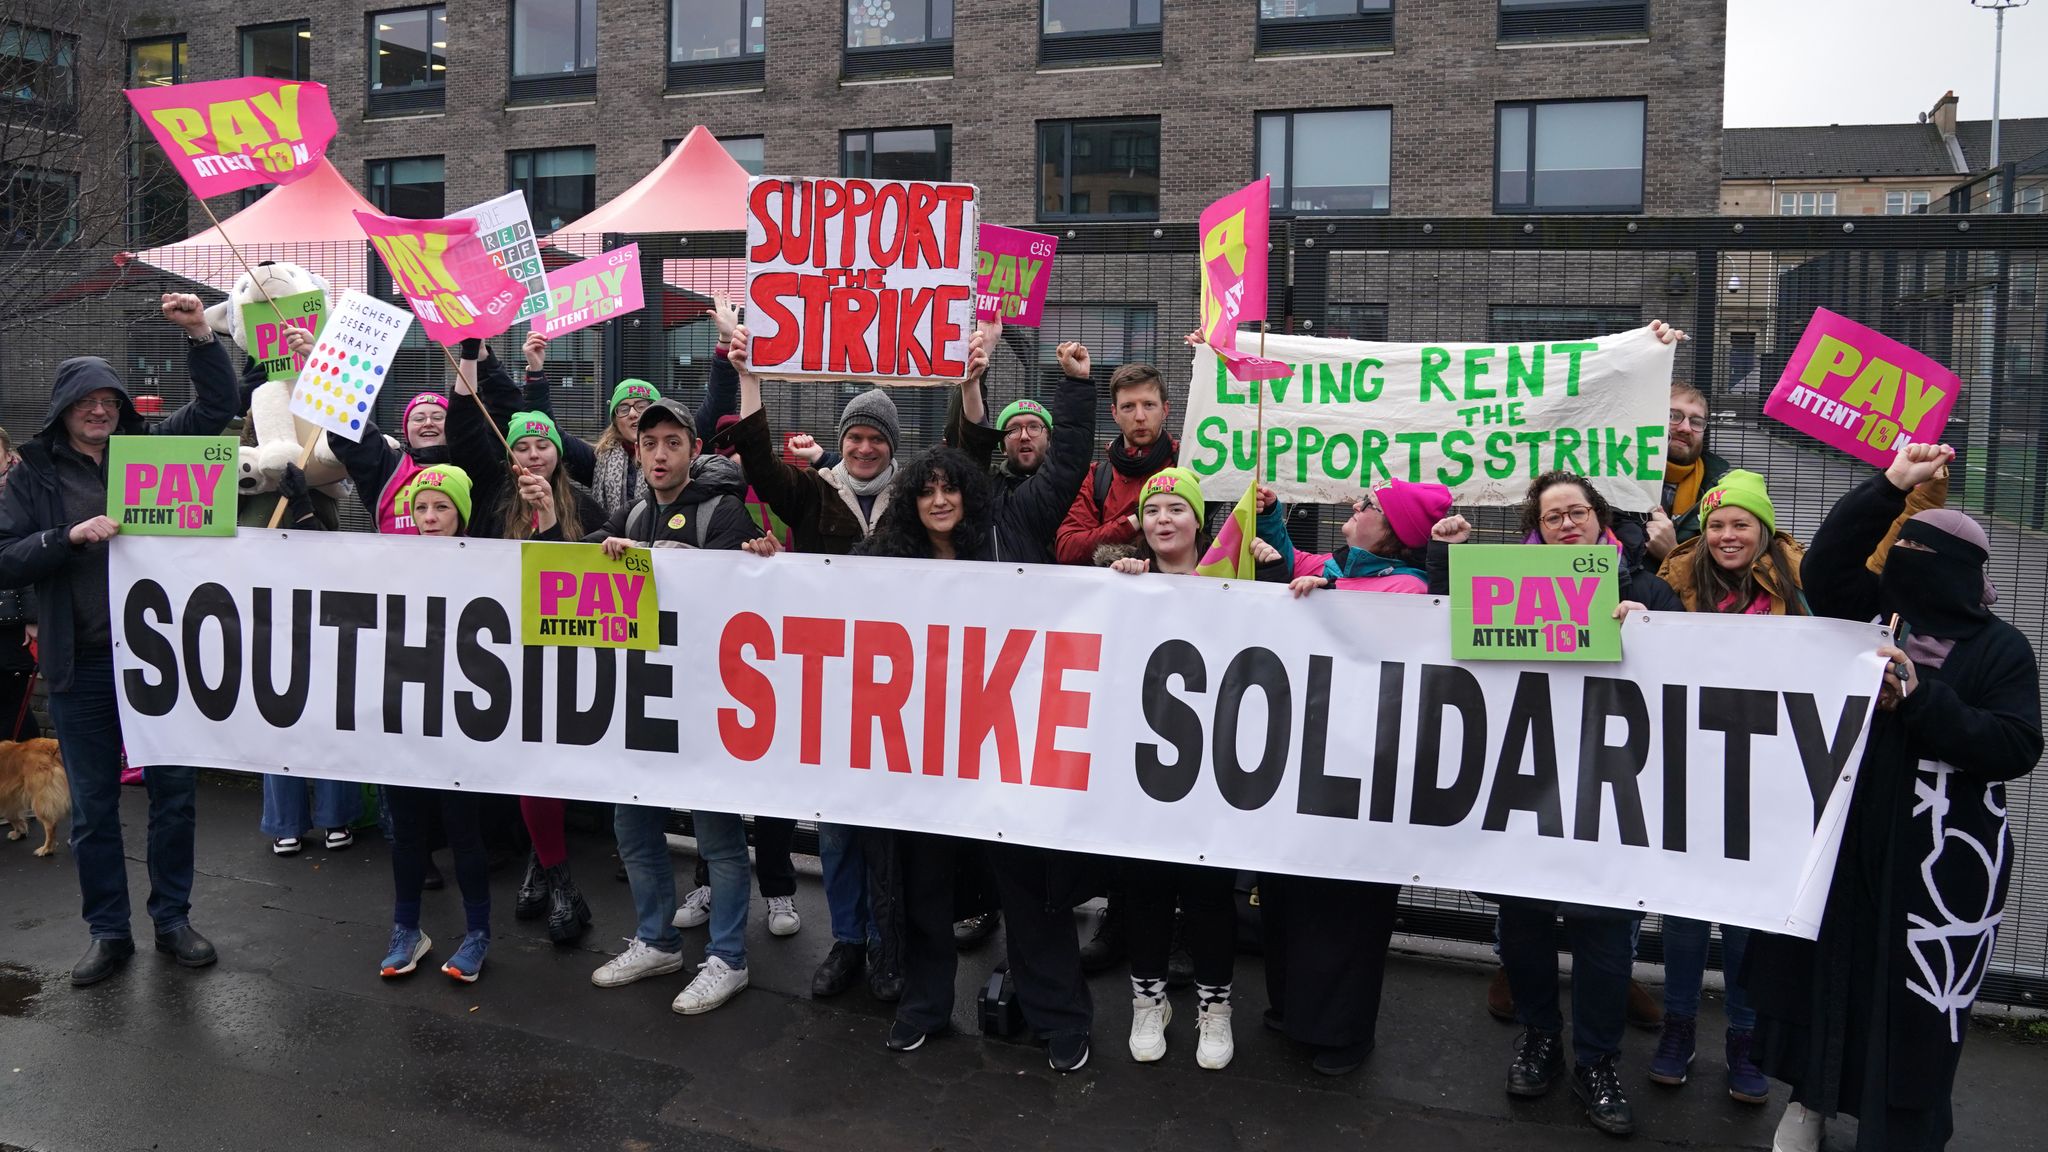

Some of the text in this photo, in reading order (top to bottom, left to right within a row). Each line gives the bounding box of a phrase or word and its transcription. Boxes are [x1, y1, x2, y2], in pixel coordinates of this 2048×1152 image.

[151, 84, 303, 157] PAY
[750, 179, 974, 270] SUPPORT
[608, 250, 633, 266] eis
[1031, 239, 1052, 257] eis
[369, 232, 462, 296] PAY
[977, 251, 1043, 299] PAY
[822, 268, 887, 289] THE
[303, 297, 322, 313] eis
[486, 290, 513, 315] eis
[545, 264, 628, 321] PAY
[347, 299, 401, 329] TEACHERS
[750, 272, 970, 377] STRIKE
[340, 315, 388, 342] DESERVE
[334, 331, 379, 356] ARRAYS
[1216, 342, 1599, 405] LIVING RENT
[1799, 334, 1947, 434] PAY
[525, 421, 550, 433] PAY
[1457, 401, 1526, 427] THE
[204, 443, 232, 461] eis
[1192, 416, 1666, 487] SUPPORTS STRIKE
[124, 463, 225, 507] PAY
[417, 472, 448, 484] PAY
[1147, 476, 1179, 490] PAY
[123, 504, 213, 529] ATTENT10N
[625, 554, 650, 573] eis
[1572, 553, 1610, 573] eis
[540, 571, 646, 620] PAY
[1471, 576, 1601, 626] PAY
[540, 615, 638, 642] ATTENT10N
[1472, 623, 1591, 653] ATTENT10N
[122, 578, 1871, 863] SOUTHSIDE STRIKE SOLIDARITY
